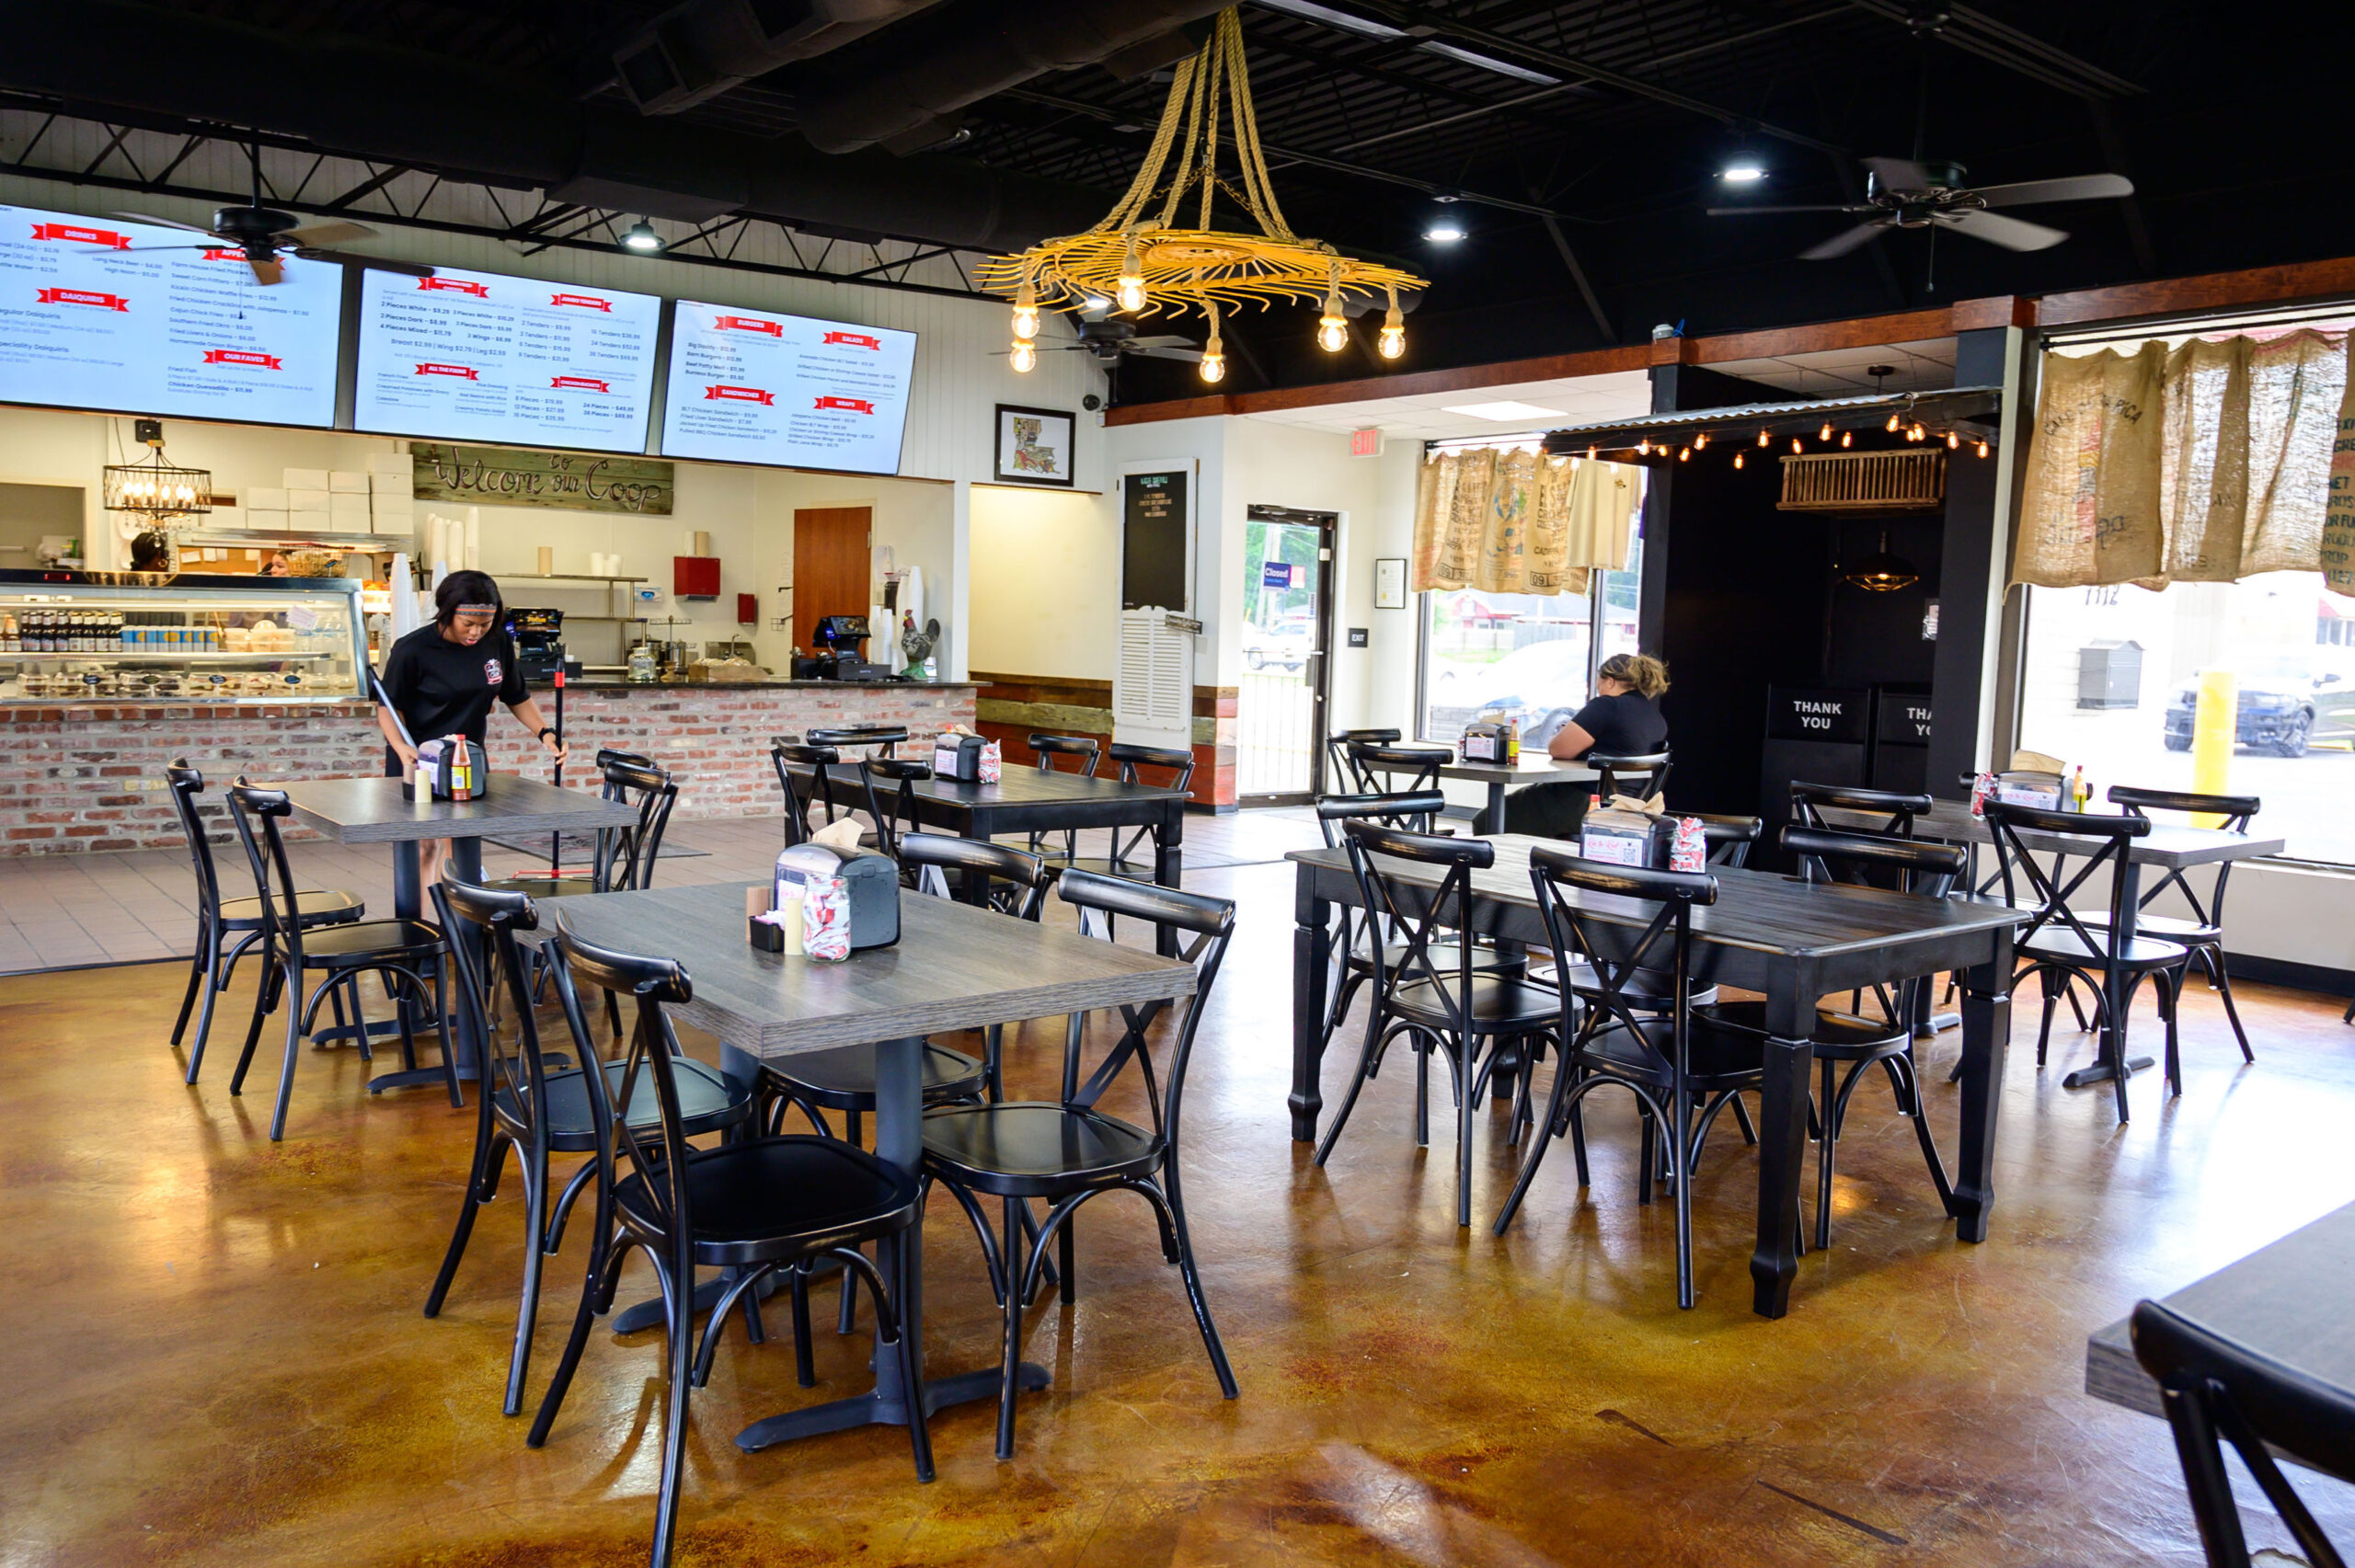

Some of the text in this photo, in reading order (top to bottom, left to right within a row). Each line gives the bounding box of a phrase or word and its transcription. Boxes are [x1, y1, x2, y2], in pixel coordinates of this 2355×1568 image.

[1354, 429, 1377, 455] EXIT
[431, 448, 661, 511] Welcome to our Coop
[1265, 567, 1289, 578] Closed
[1533, 575, 1545, 586] 09
[1794, 701, 1842, 715] THANK
[1801, 716, 1831, 729] YOU
